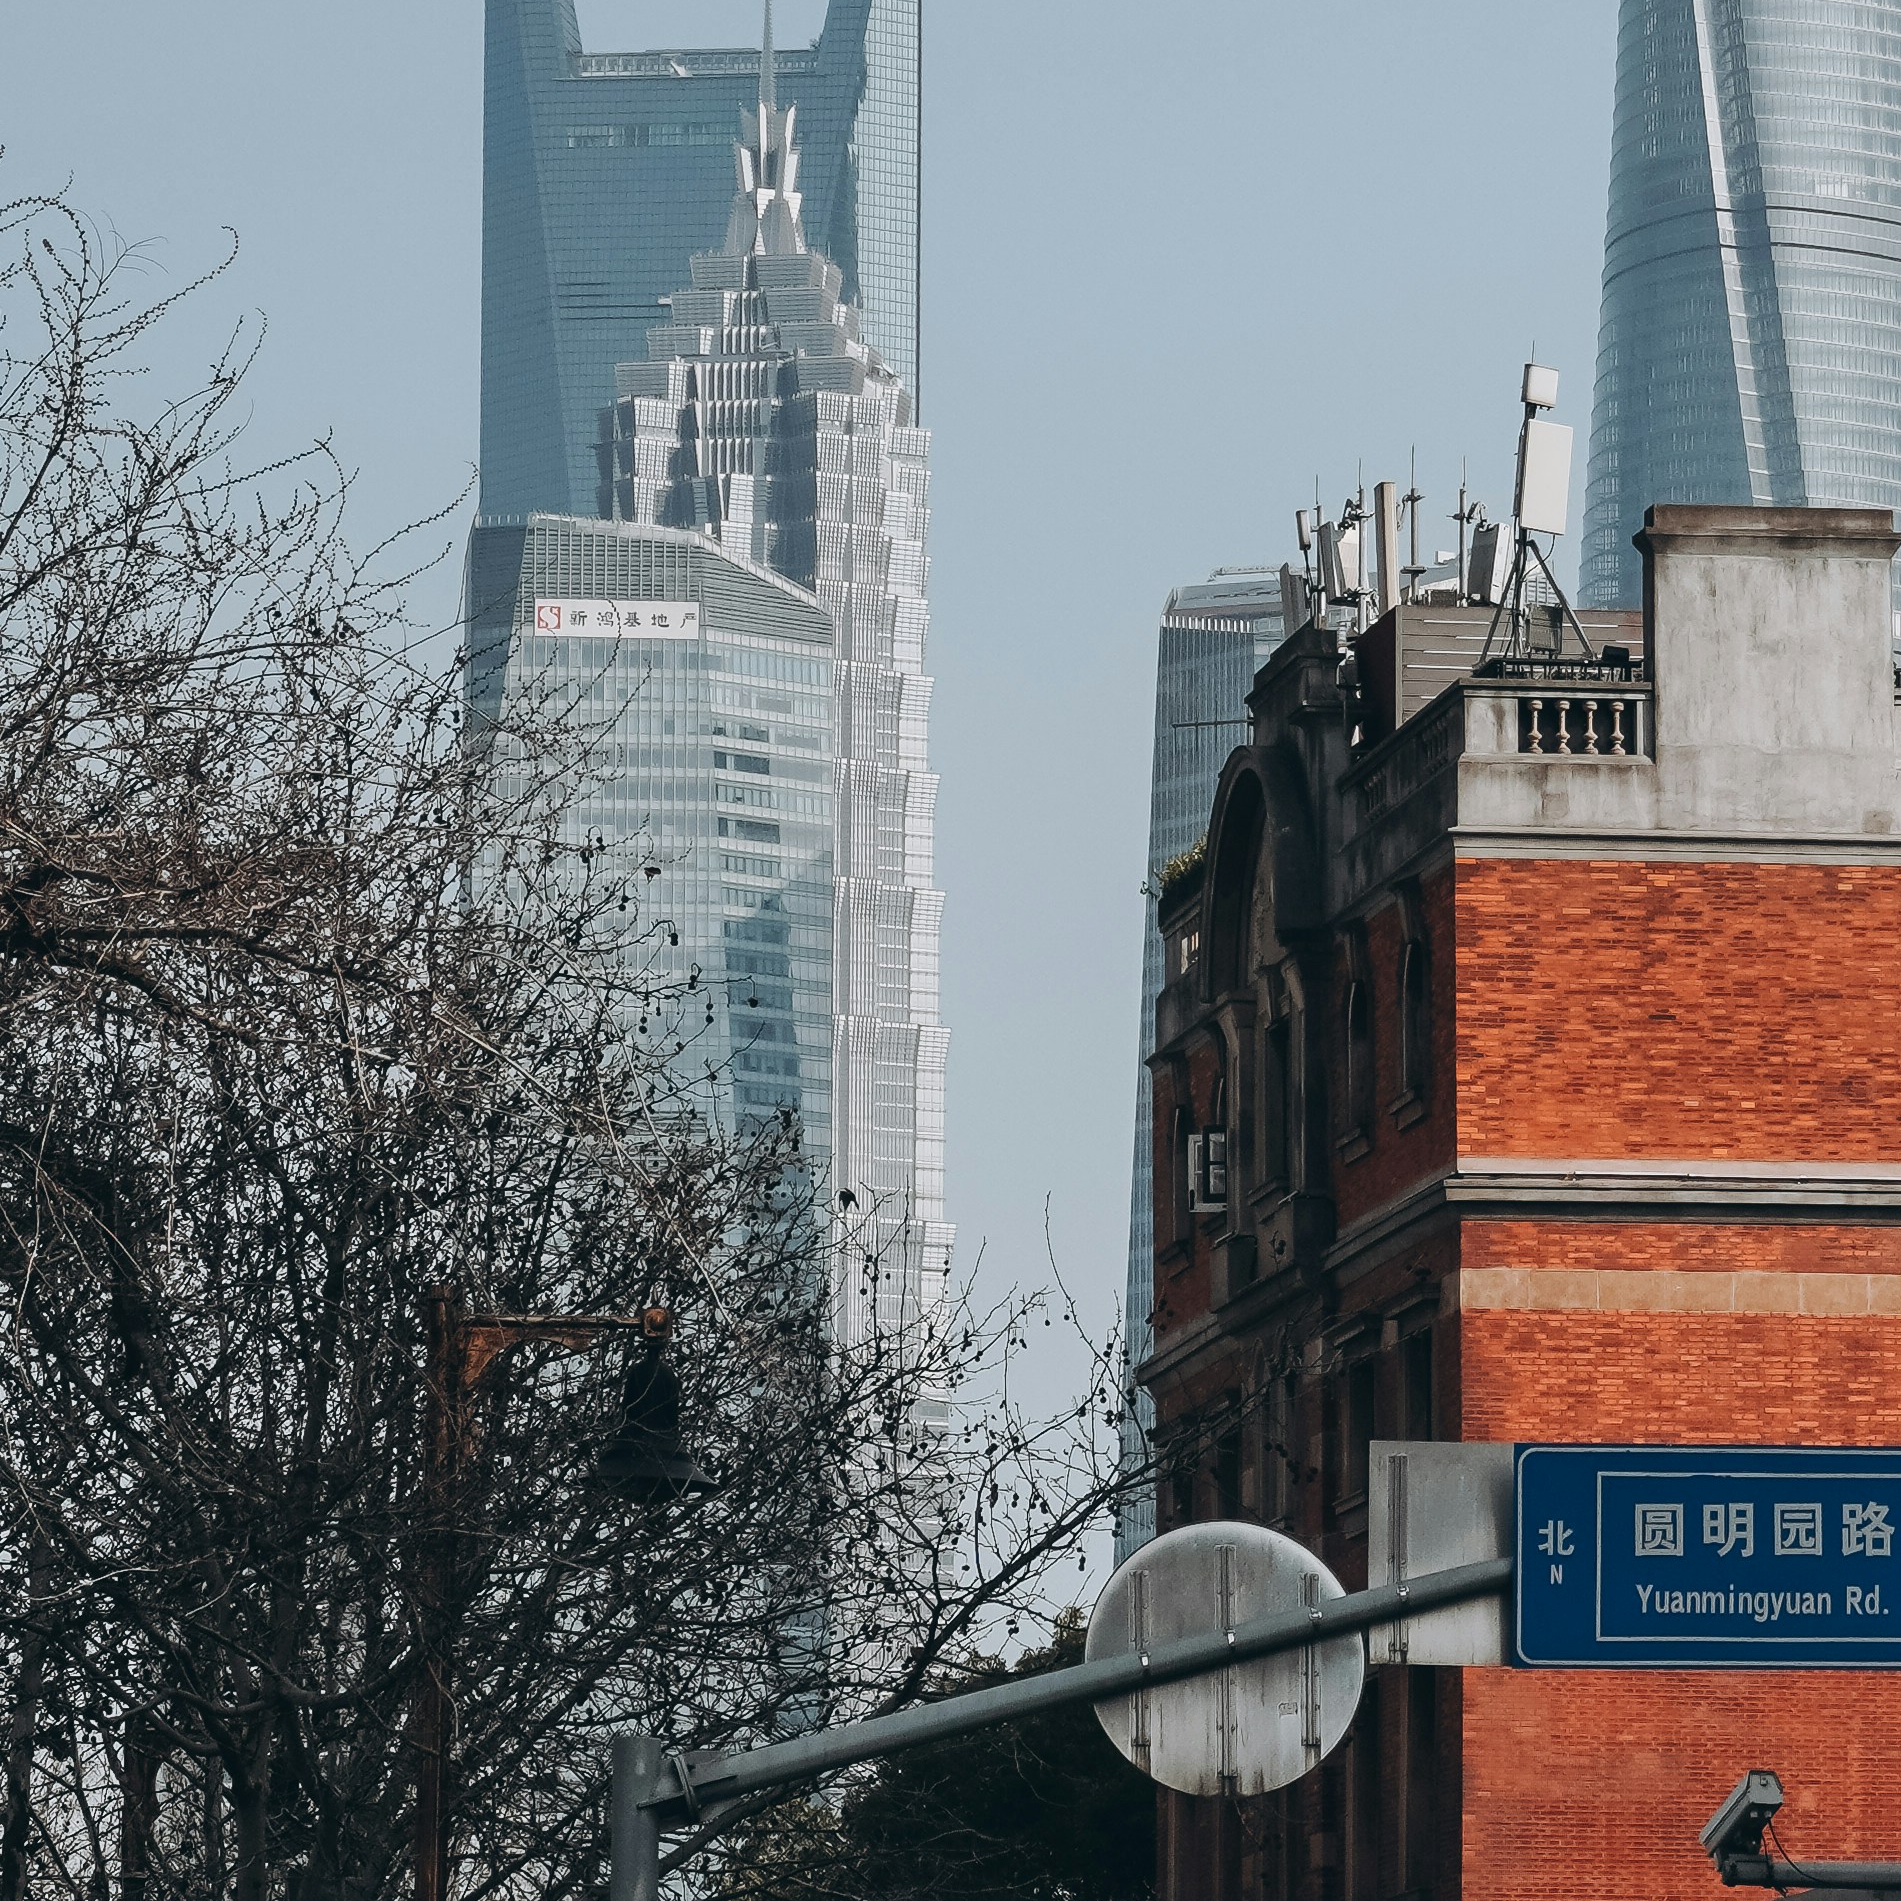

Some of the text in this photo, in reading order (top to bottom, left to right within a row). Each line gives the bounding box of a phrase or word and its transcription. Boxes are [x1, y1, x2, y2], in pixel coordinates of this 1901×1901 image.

[569, 610, 697, 629] 新鸿基地产
[1539, 1520, 1574, 1556] 北
[1634, 1501, 1895, 1558] 圆明园路
[1550, 1564, 1563, 1585] N
[1636, 1584, 1889, 1623] Yuanmingyuan Rd.
